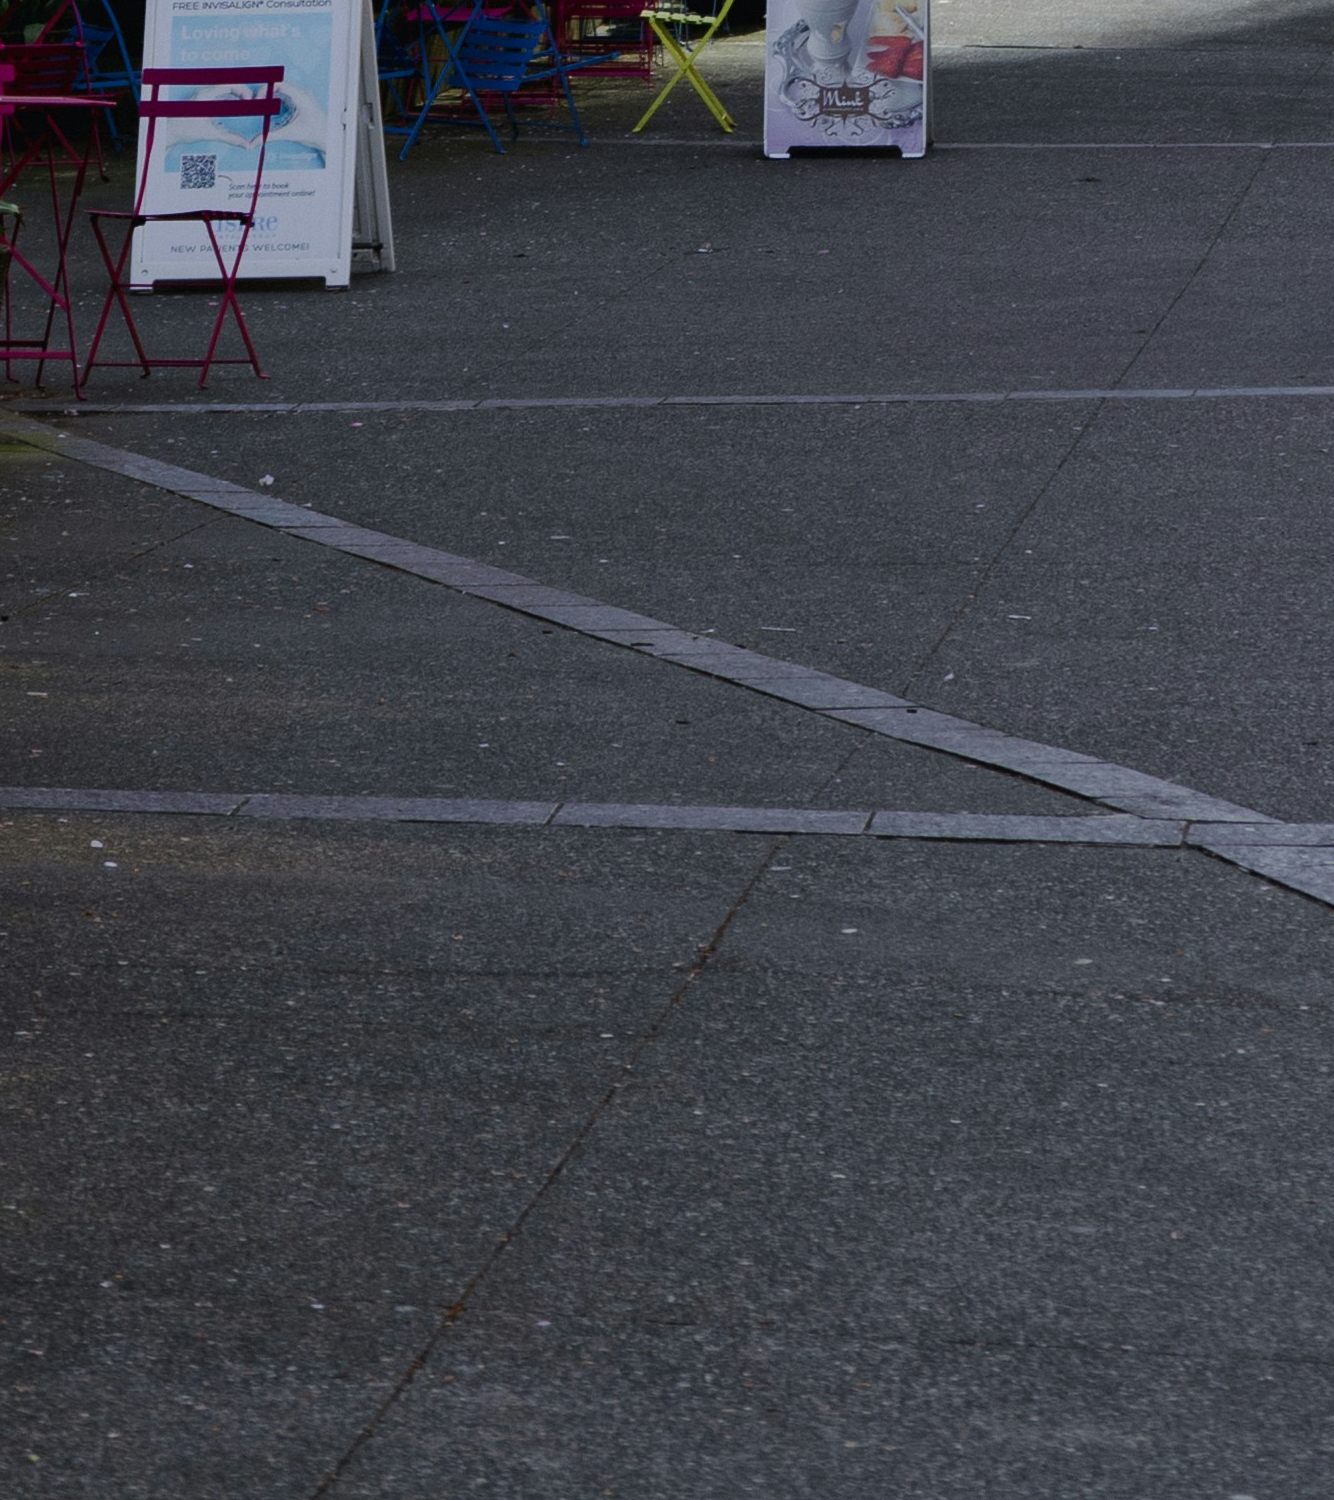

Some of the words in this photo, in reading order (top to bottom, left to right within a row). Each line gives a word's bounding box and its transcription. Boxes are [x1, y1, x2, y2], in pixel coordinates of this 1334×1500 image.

[172, 2, 199, 11] FREE
[181, 23, 240, 44] Loving
[243, 21, 302, 40] what's
[180, 49, 197, 62] to
[200, 49, 251, 62] come
[822, 90, 864, 107] Mint
[228, 182, 246, 190] Scan
[170, 245, 196, 253] NEW
[251, 243, 310, 252] WELCOME!
